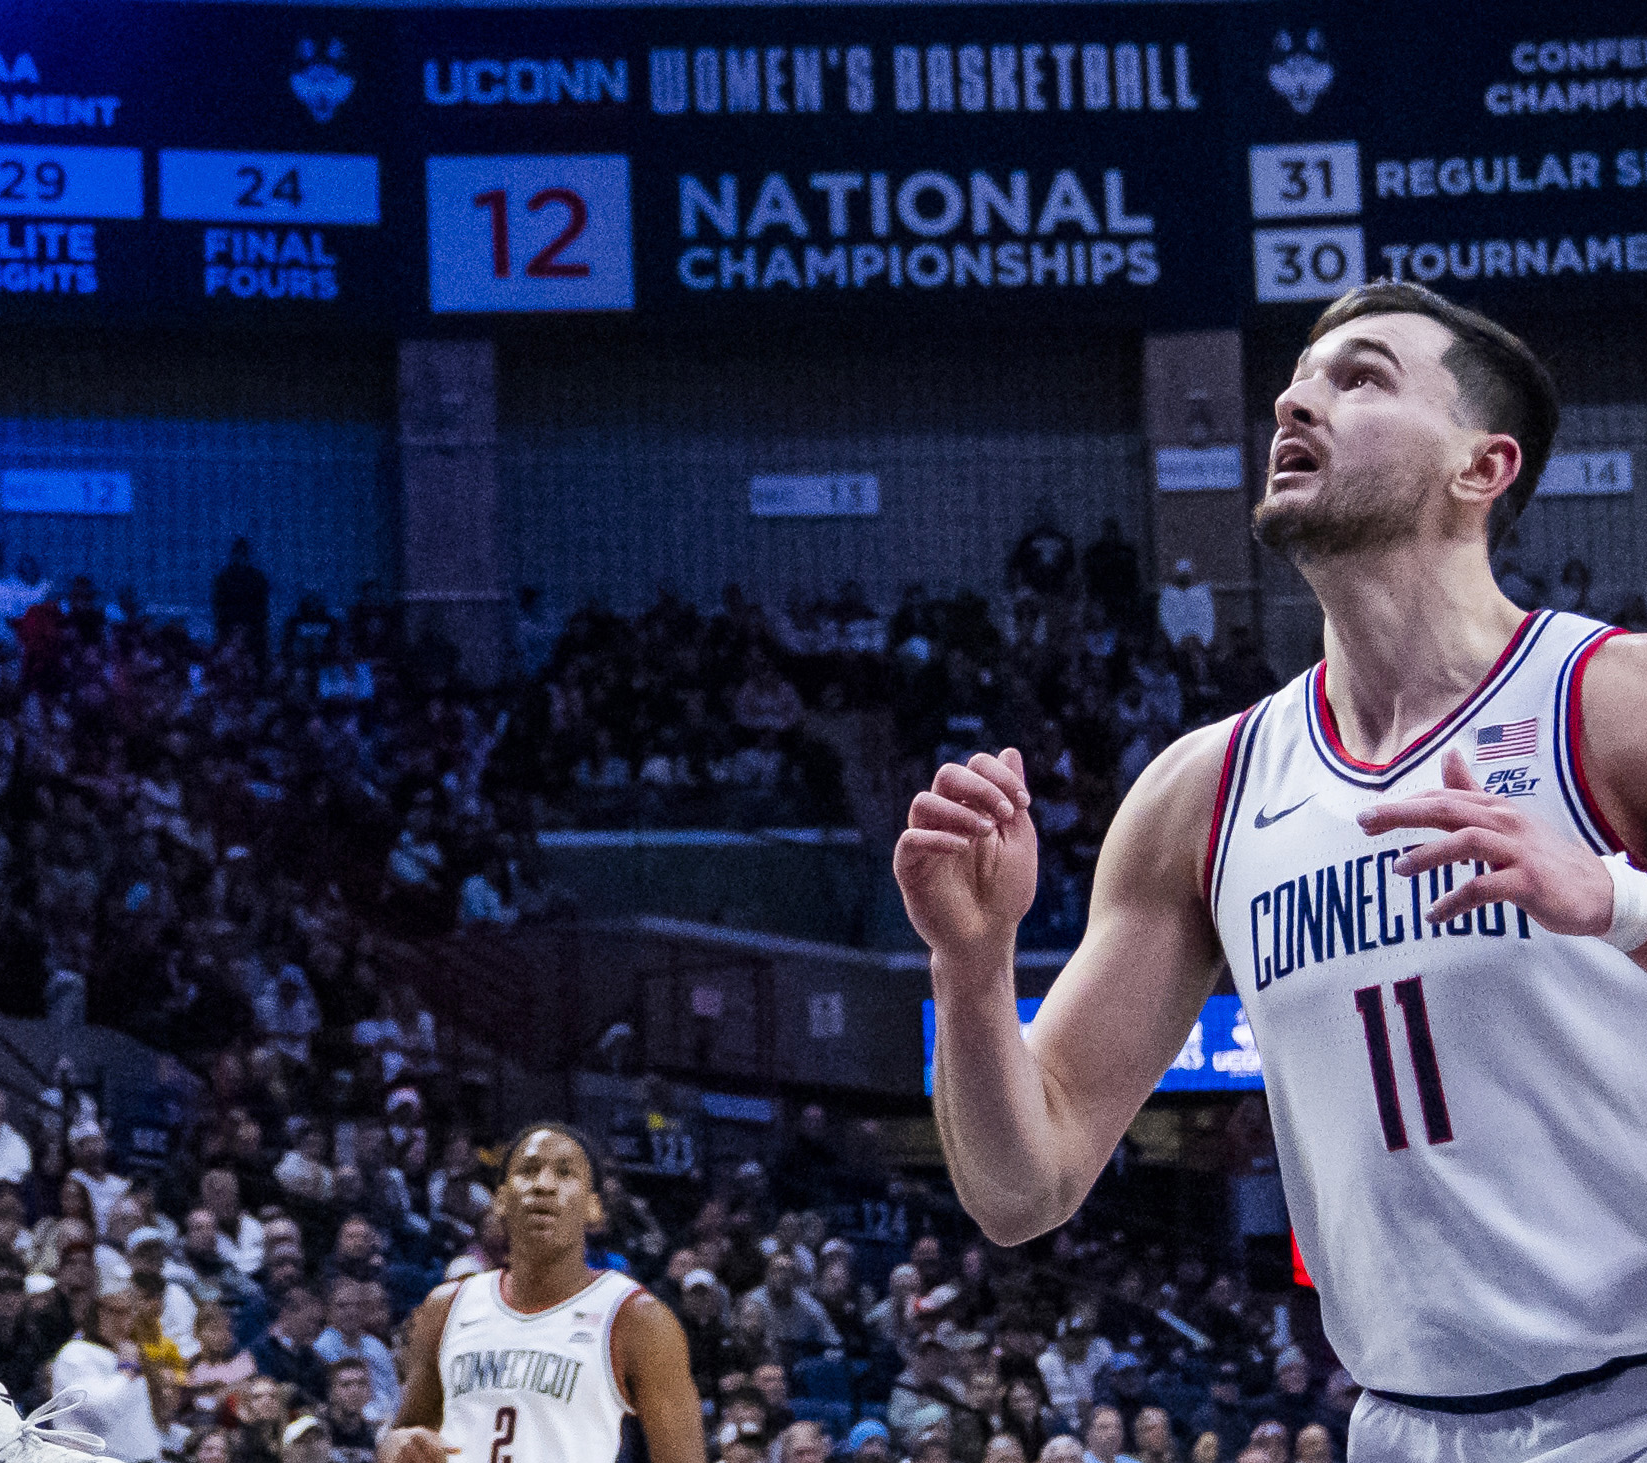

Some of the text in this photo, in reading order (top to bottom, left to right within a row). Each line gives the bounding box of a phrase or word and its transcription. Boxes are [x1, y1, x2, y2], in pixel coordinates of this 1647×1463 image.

[423, 44, 1199, 116] UCONN WOMEN'S BASKETBALL
[235, 166, 304, 209] 24
[1276, 158, 1337, 209] 31
[1374, 153, 1608, 200] REGULAR
[204, 227, 337, 268] FINAL
[473, 166, 1156, 281] 12 NATIONAL
[204, 265, 340, 302] FOURS
[678, 236, 1162, 292] CHAMPIONSHIPS
[1272, 238, 1350, 291] 30
[1487, 766, 1529, 785] BIG
[1353, 975, 1454, 1153] 11
[450, 1348, 584, 1405] CONNECTICUT
